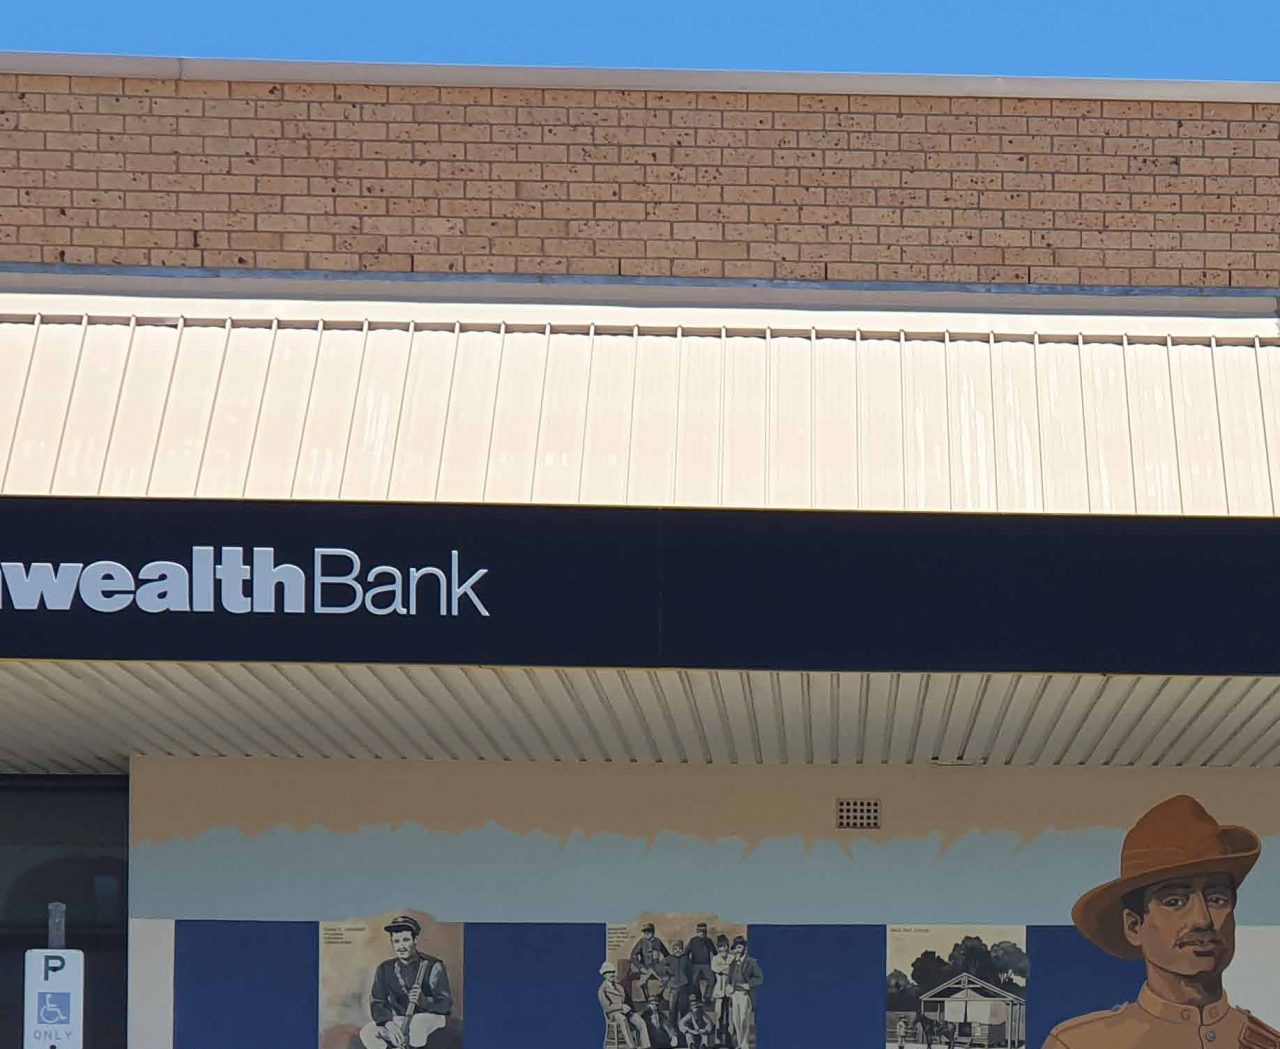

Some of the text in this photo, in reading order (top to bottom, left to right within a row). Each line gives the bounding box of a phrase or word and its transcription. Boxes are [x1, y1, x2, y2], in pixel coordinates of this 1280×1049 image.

[0, 546, 490, 616] wealthBank
[44, 955, 65, 981] P
[33, 1030, 73, 1040] ONLY
